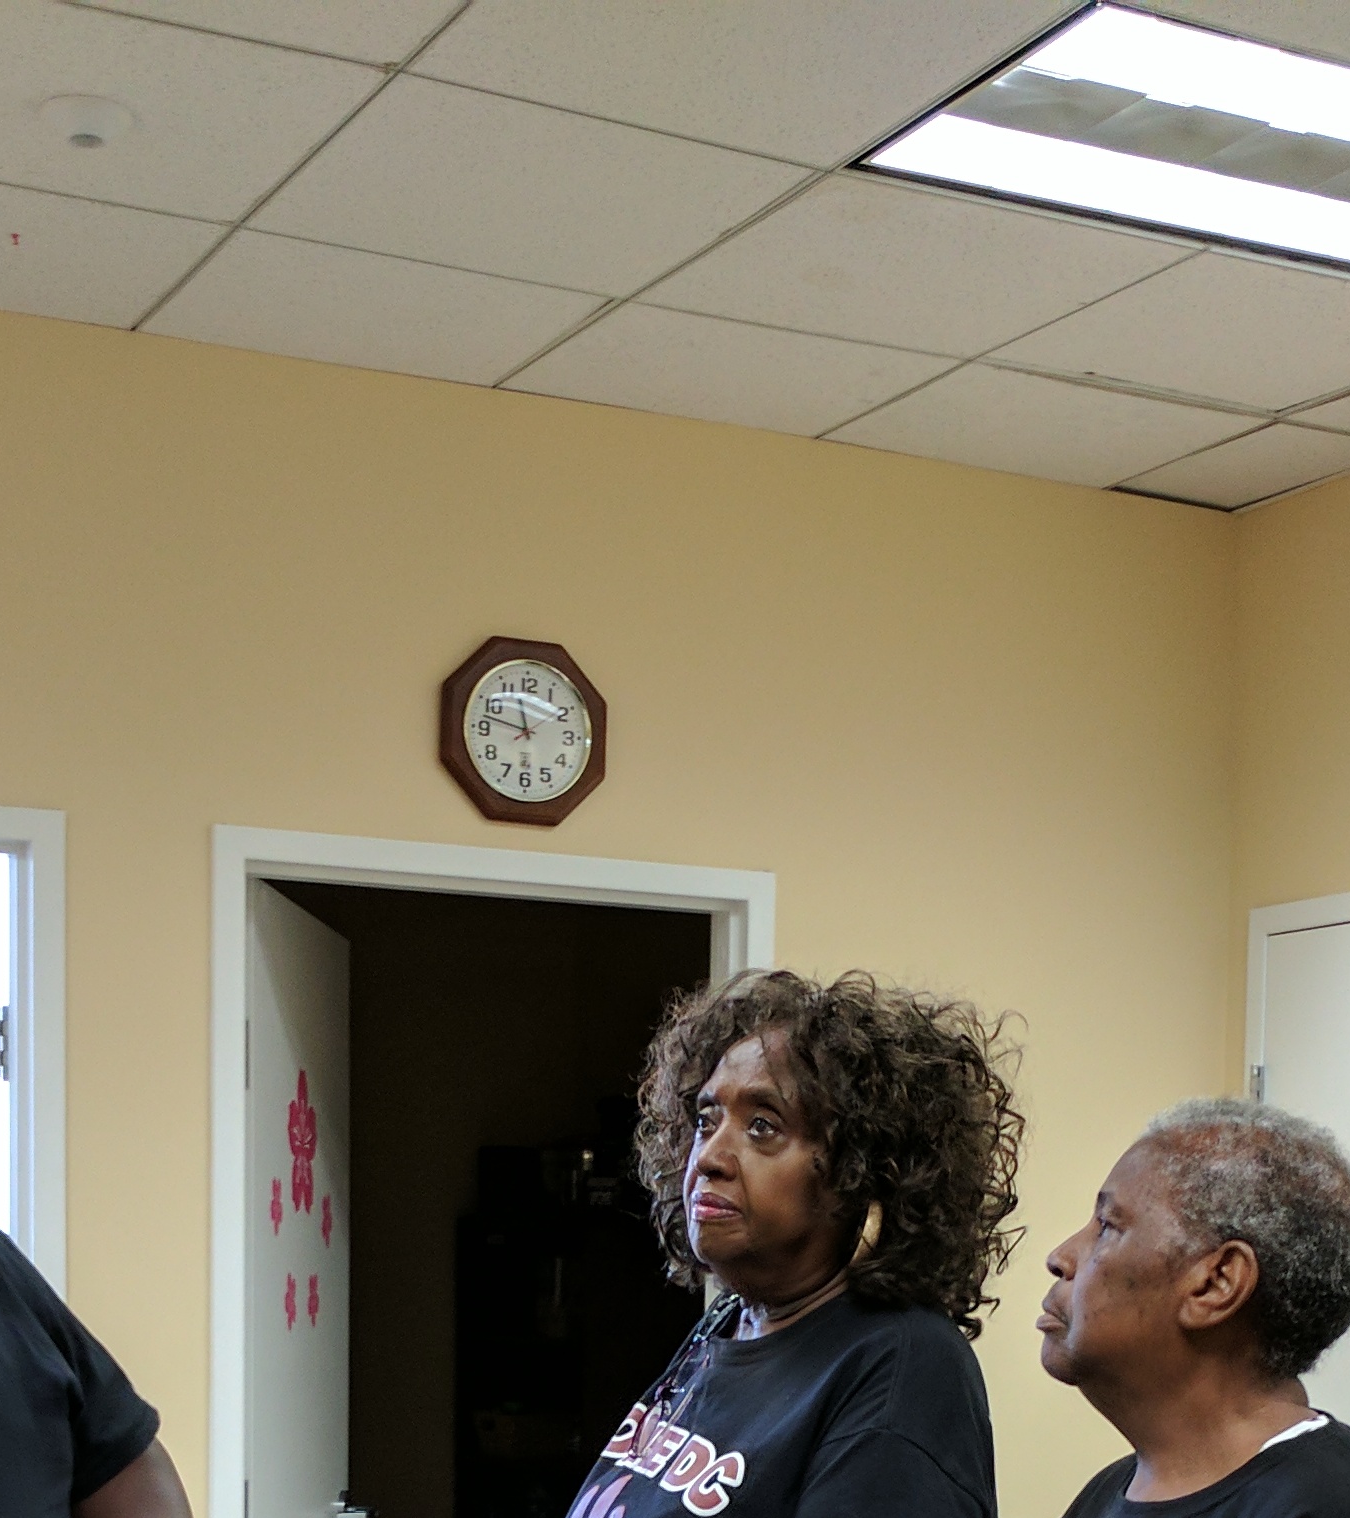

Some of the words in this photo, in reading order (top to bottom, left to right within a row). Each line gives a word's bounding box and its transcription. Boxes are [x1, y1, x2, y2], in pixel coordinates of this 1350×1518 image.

[521, 677, 539, 694] 12
[484, 698, 503, 715] 10
[556, 706, 569, 723] 2
[477, 720, 491, 737] 9
[561, 730, 575, 747] 3
[484, 744, 498, 760] 8
[554, 753, 568, 768] 4
[500, 762, 512, 778] 7
[539, 767, 552, 783] 5
[519, 772, 531, 788] 6
[658, 1432, 746, 1518] DC
